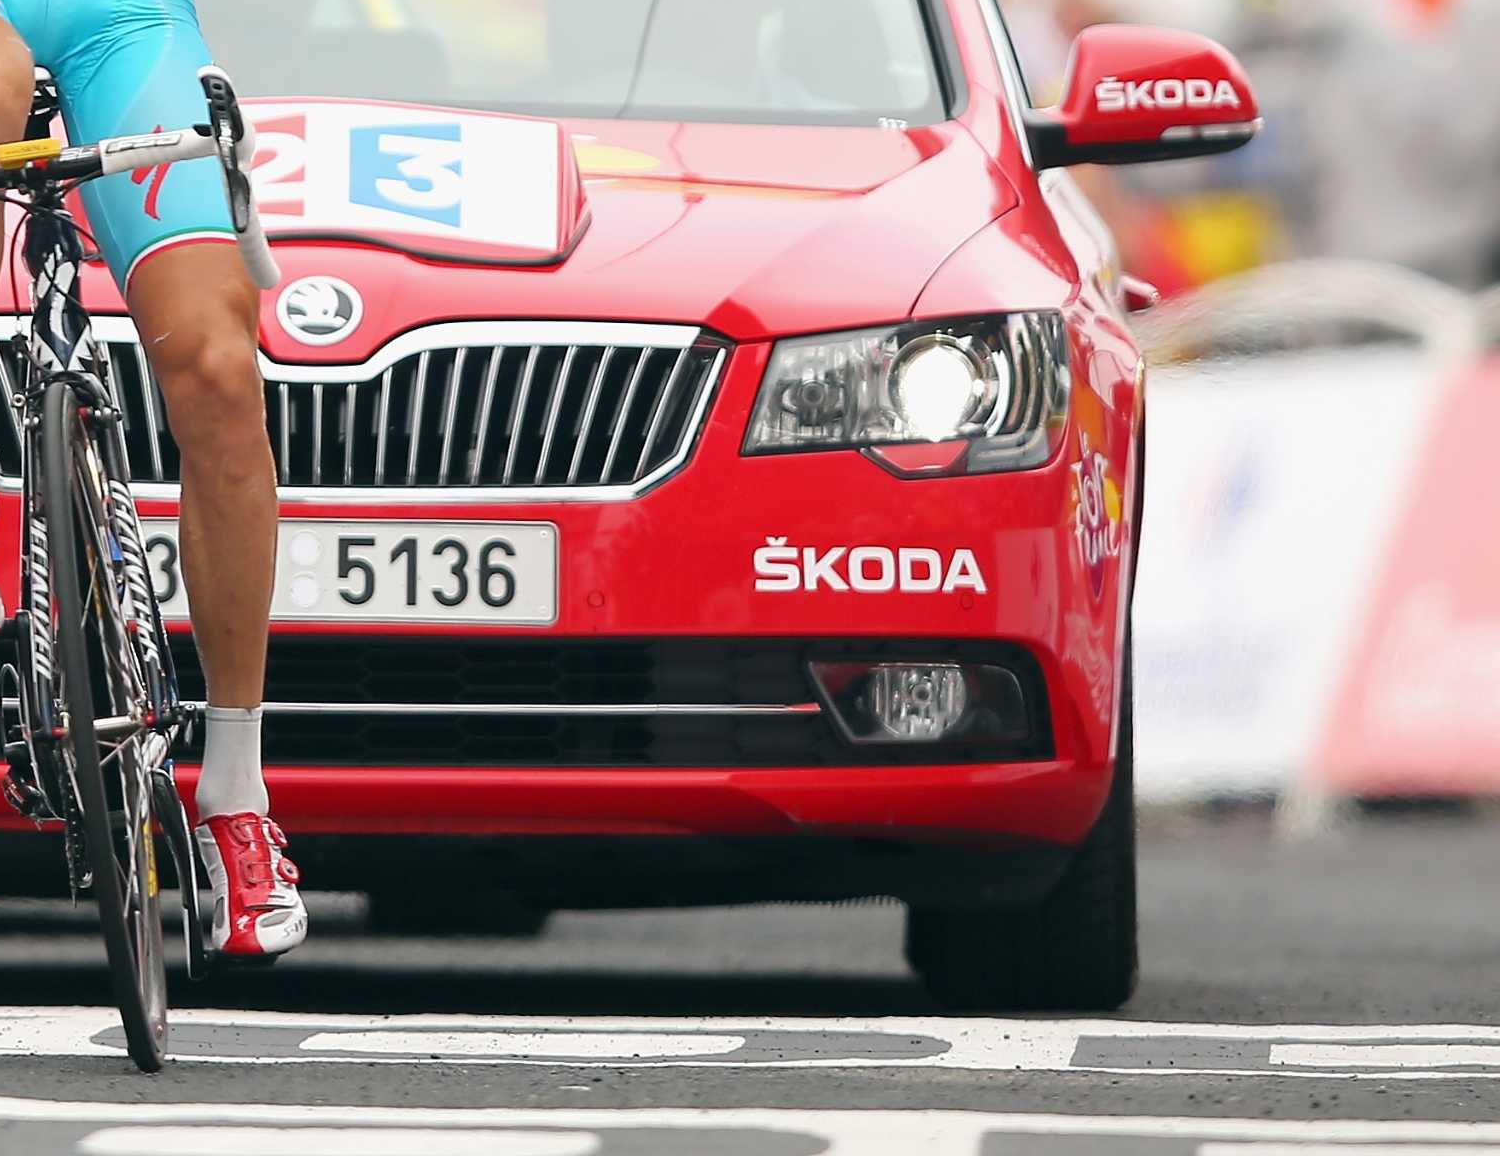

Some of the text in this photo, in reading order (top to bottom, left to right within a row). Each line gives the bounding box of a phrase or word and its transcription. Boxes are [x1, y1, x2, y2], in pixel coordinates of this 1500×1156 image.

[1094, 76, 1241, 112] ŠKODA
[336, 535, 517, 607] 5136
[753, 535, 988, 594] ŠKODA
